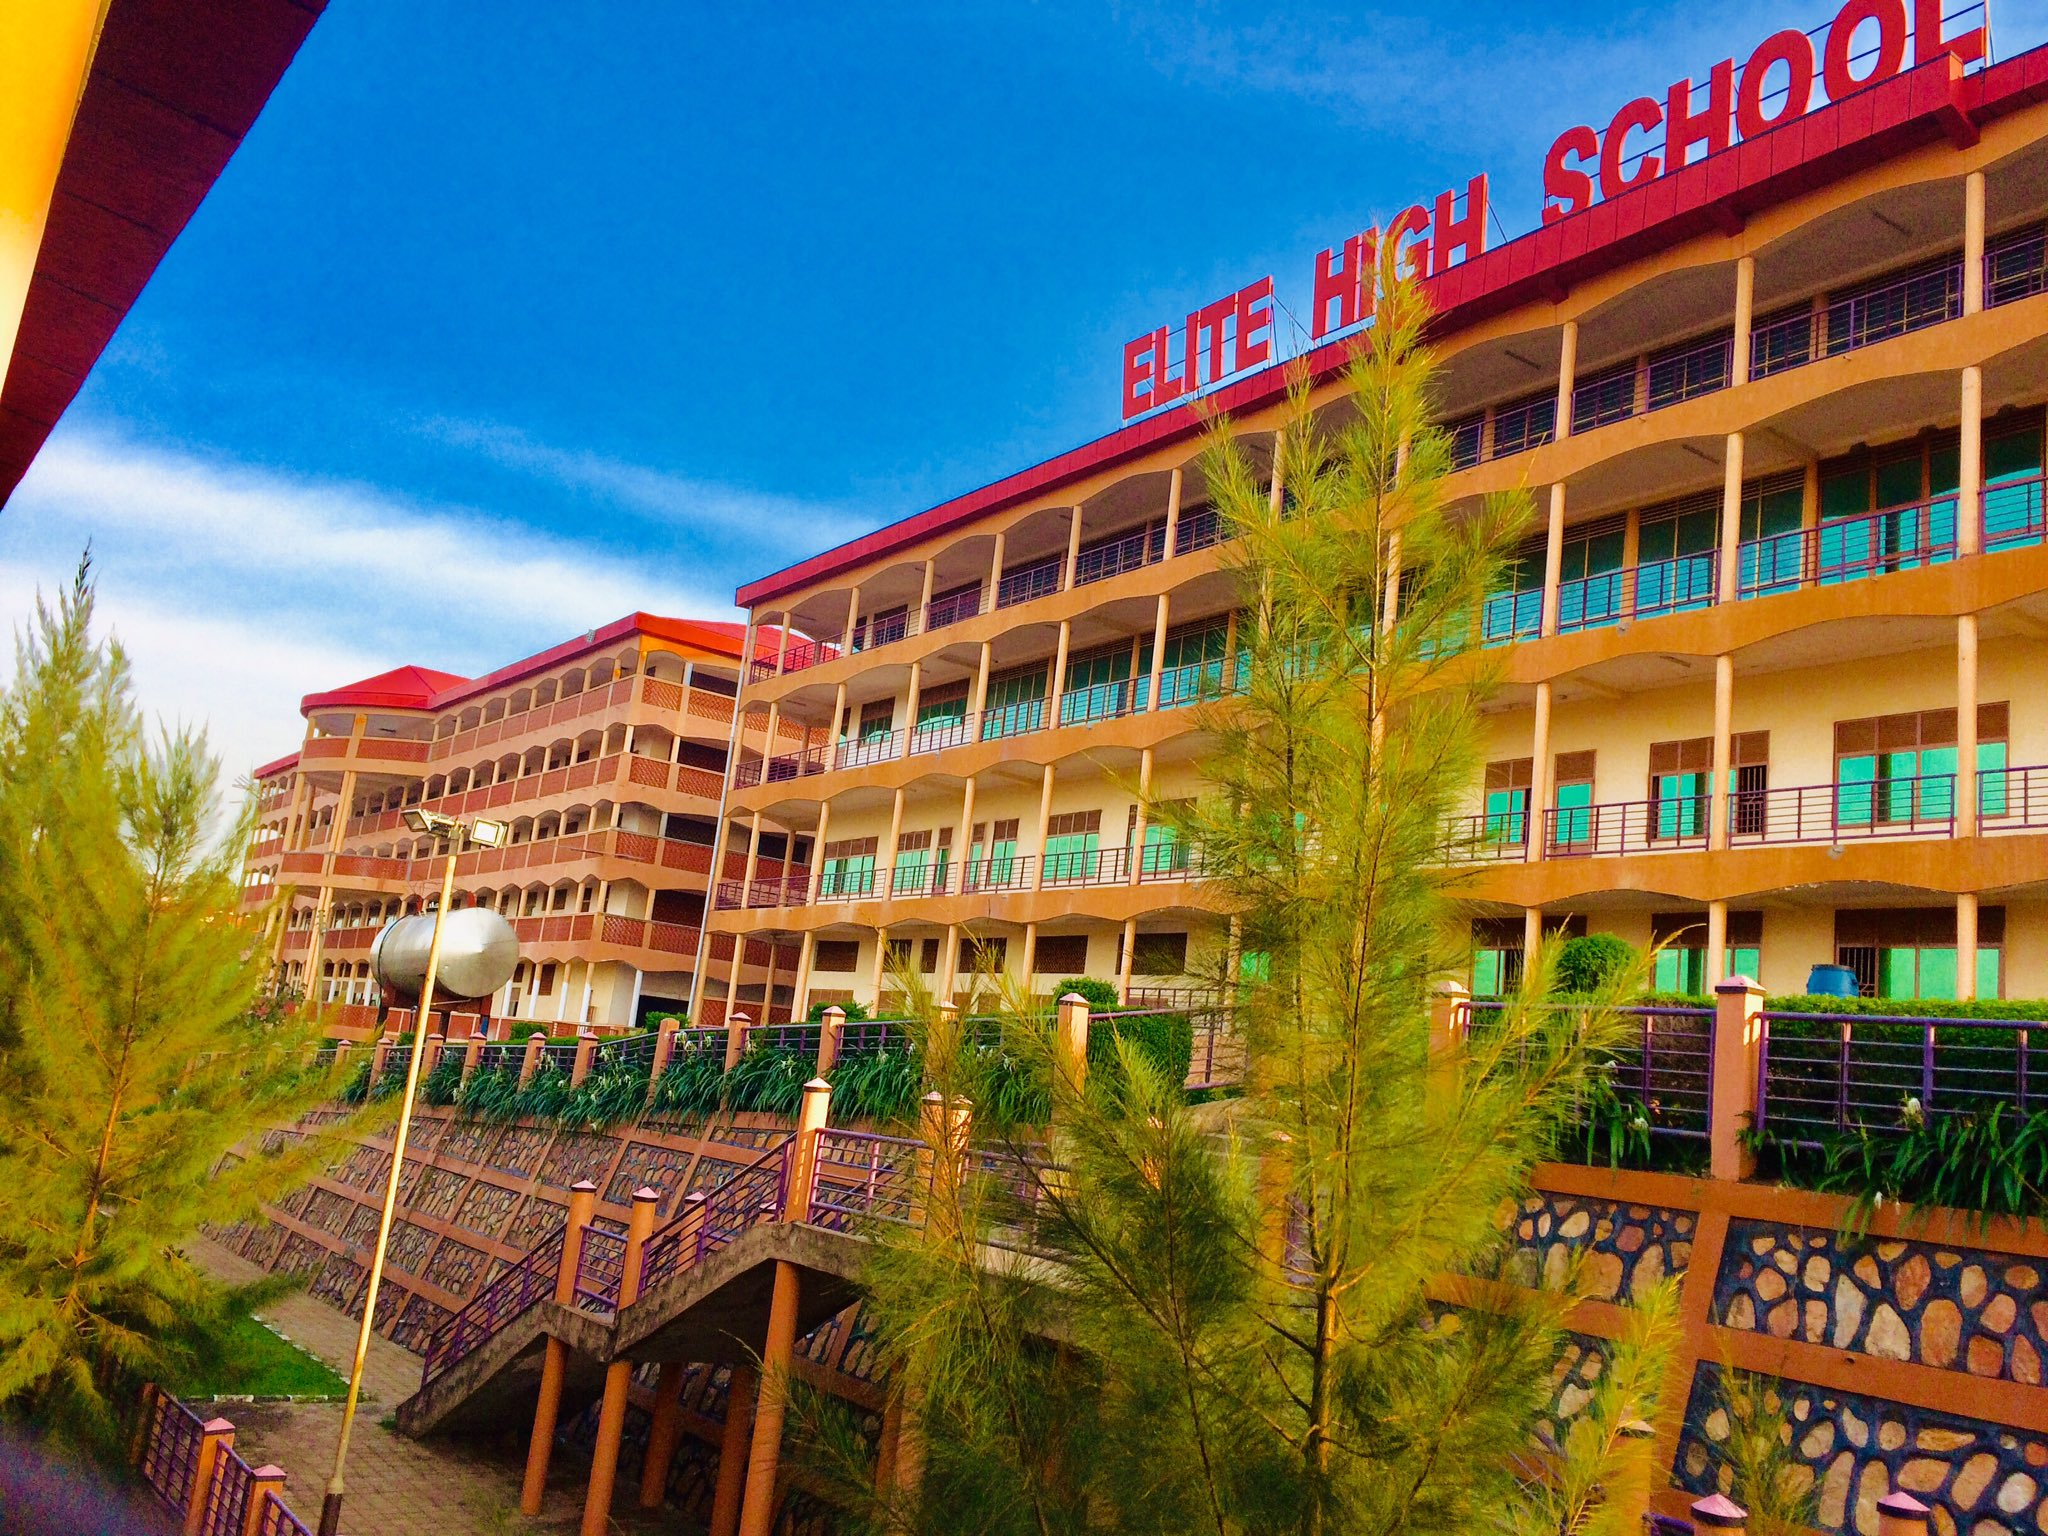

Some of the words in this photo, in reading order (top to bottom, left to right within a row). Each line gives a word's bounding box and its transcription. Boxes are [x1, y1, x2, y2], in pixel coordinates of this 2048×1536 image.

[1123, 275, 1272, 419] ELITE
[1312, 173, 1488, 340] HIGH
[1542, 0, 1986, 227] SCHOOL
